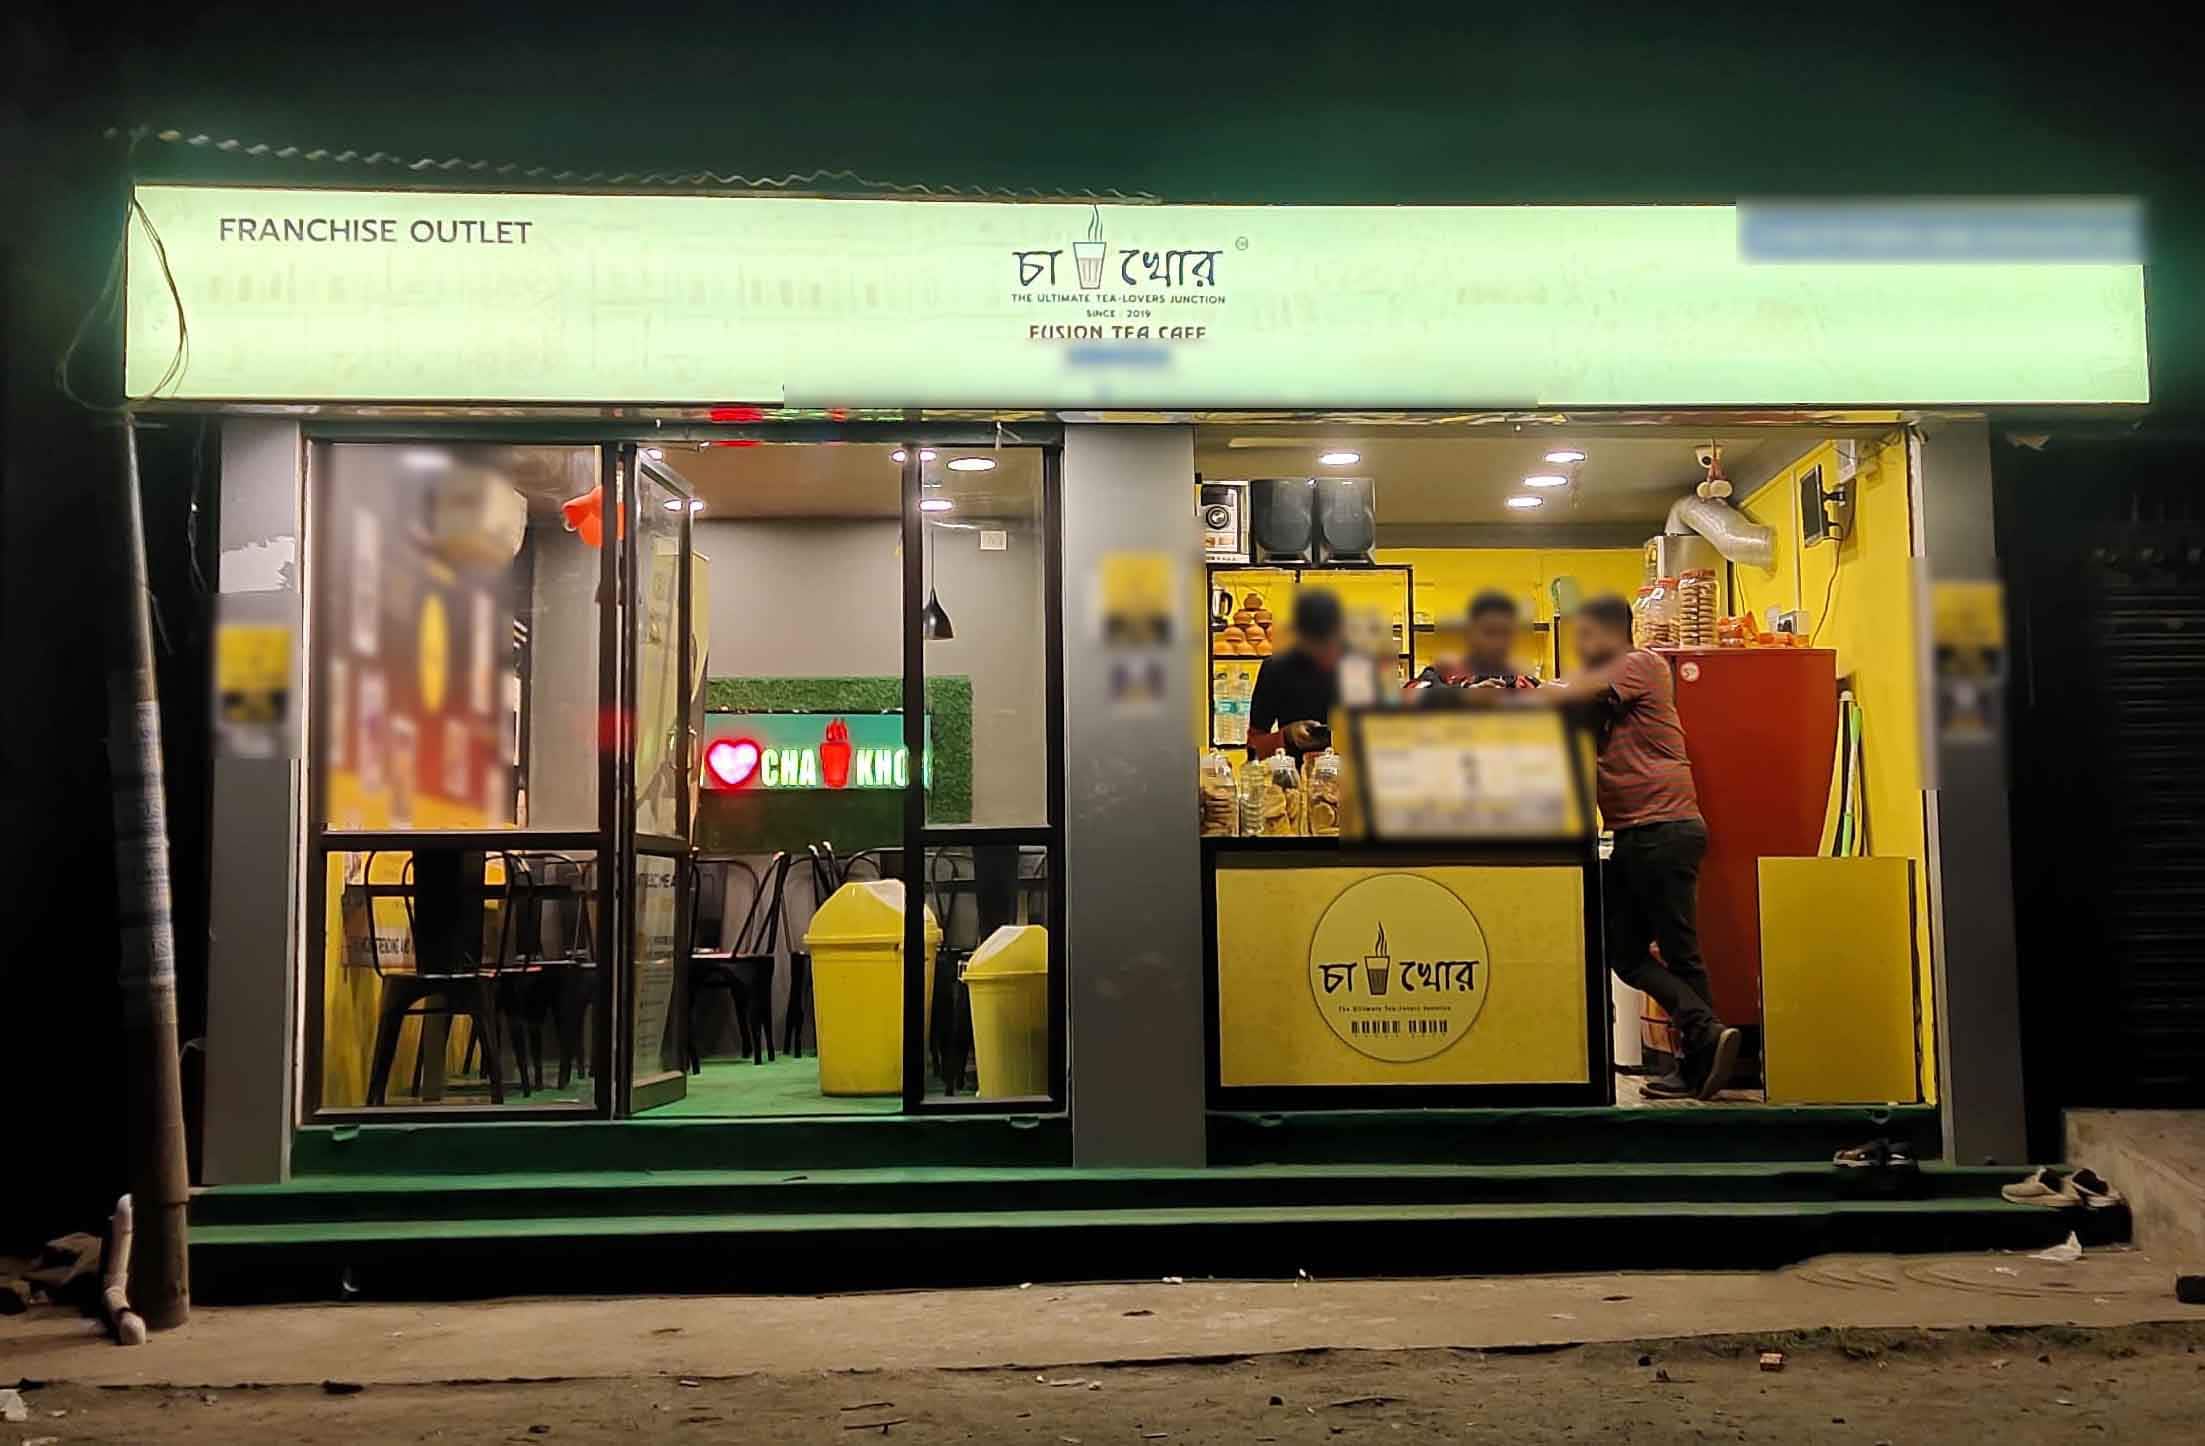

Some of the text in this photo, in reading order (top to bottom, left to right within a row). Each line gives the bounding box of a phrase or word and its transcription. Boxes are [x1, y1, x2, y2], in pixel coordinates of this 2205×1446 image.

[220, 218, 532, 244] FRANCHISE OUTLET
[1012, 250, 1223, 287] চা খোর
[1011, 294, 1032, 303] THE
[1037, 294, 1090, 303] ULTIMATE
[1170, 295, 1226, 304] JUNCTION
[1086, 309, 1151, 319] SINCE 2019
[1029, 325, 1206, 339] FUSION TEA CAFE
[760, 748, 817, 787] CHA
[1319, 960, 1480, 994] চা খোর
